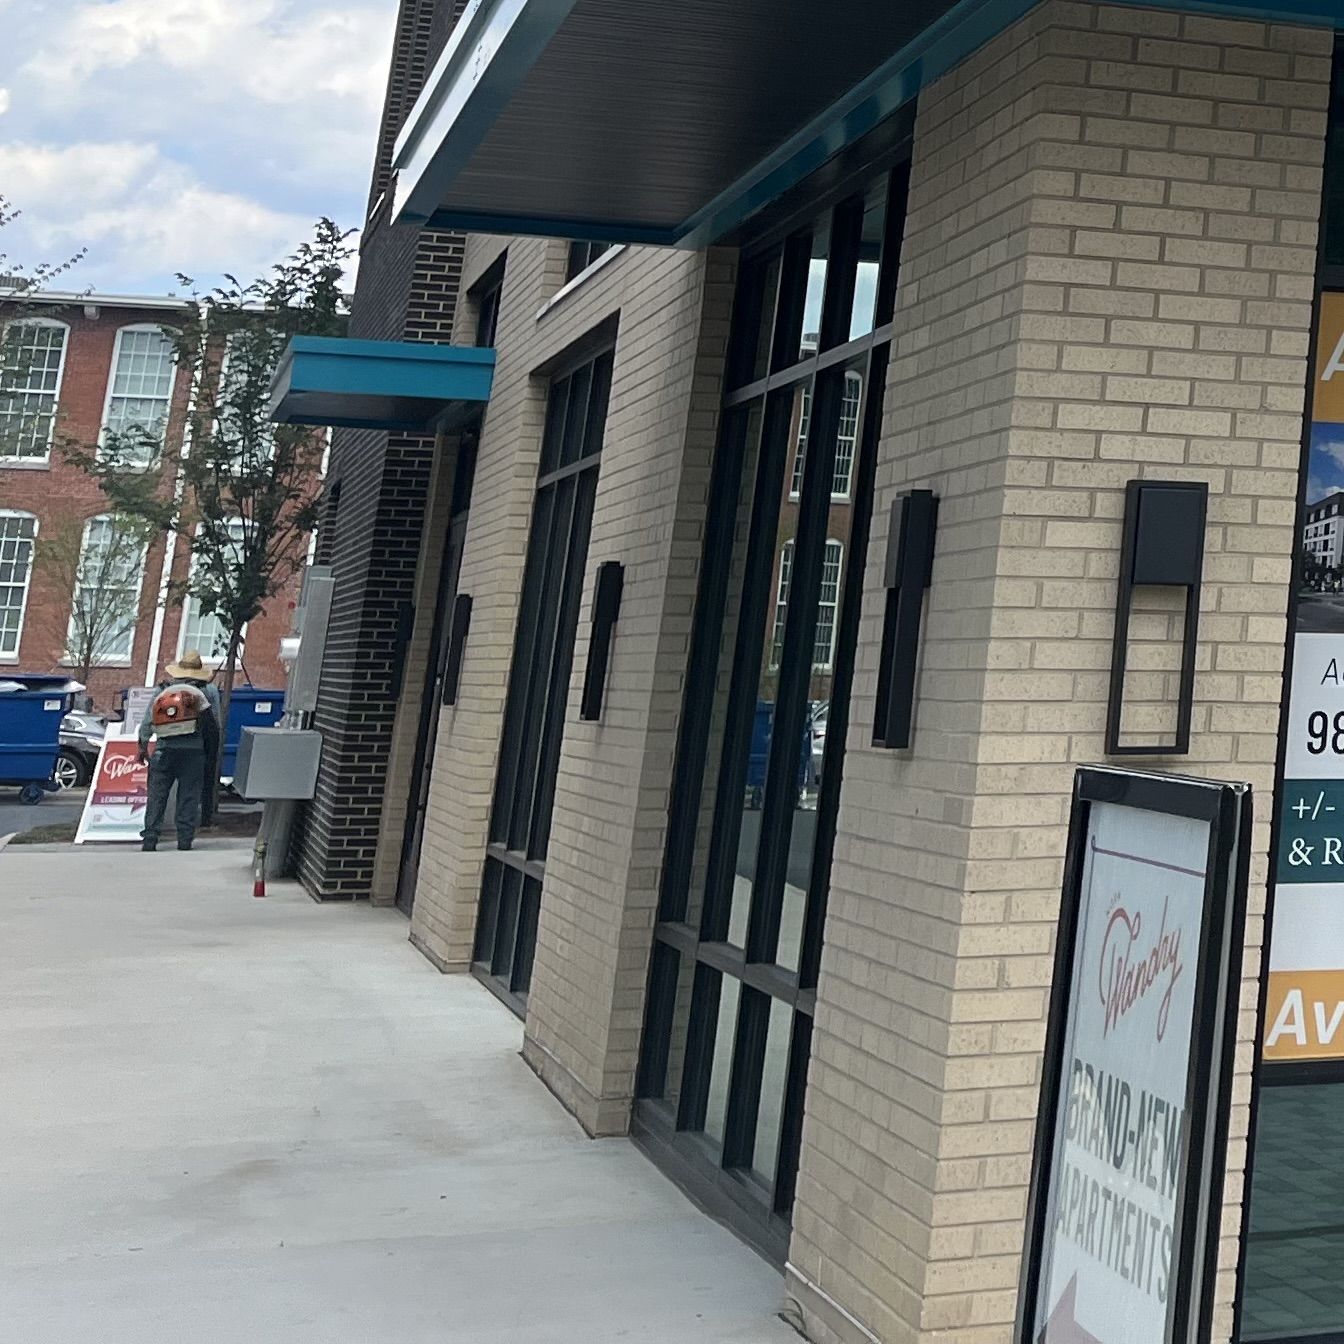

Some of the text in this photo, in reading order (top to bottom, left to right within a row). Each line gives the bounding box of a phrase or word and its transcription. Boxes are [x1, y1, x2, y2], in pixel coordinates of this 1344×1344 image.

[1288, 837, 1315, 866] &
[1291, 791, 1336, 821] +/-
[1099, 895, 1183, 1044] Wandry
[1066, 1057, 1184, 1200] BRAND-NEW
[1056, 1162, 1173, 1304] APARTMENTS
